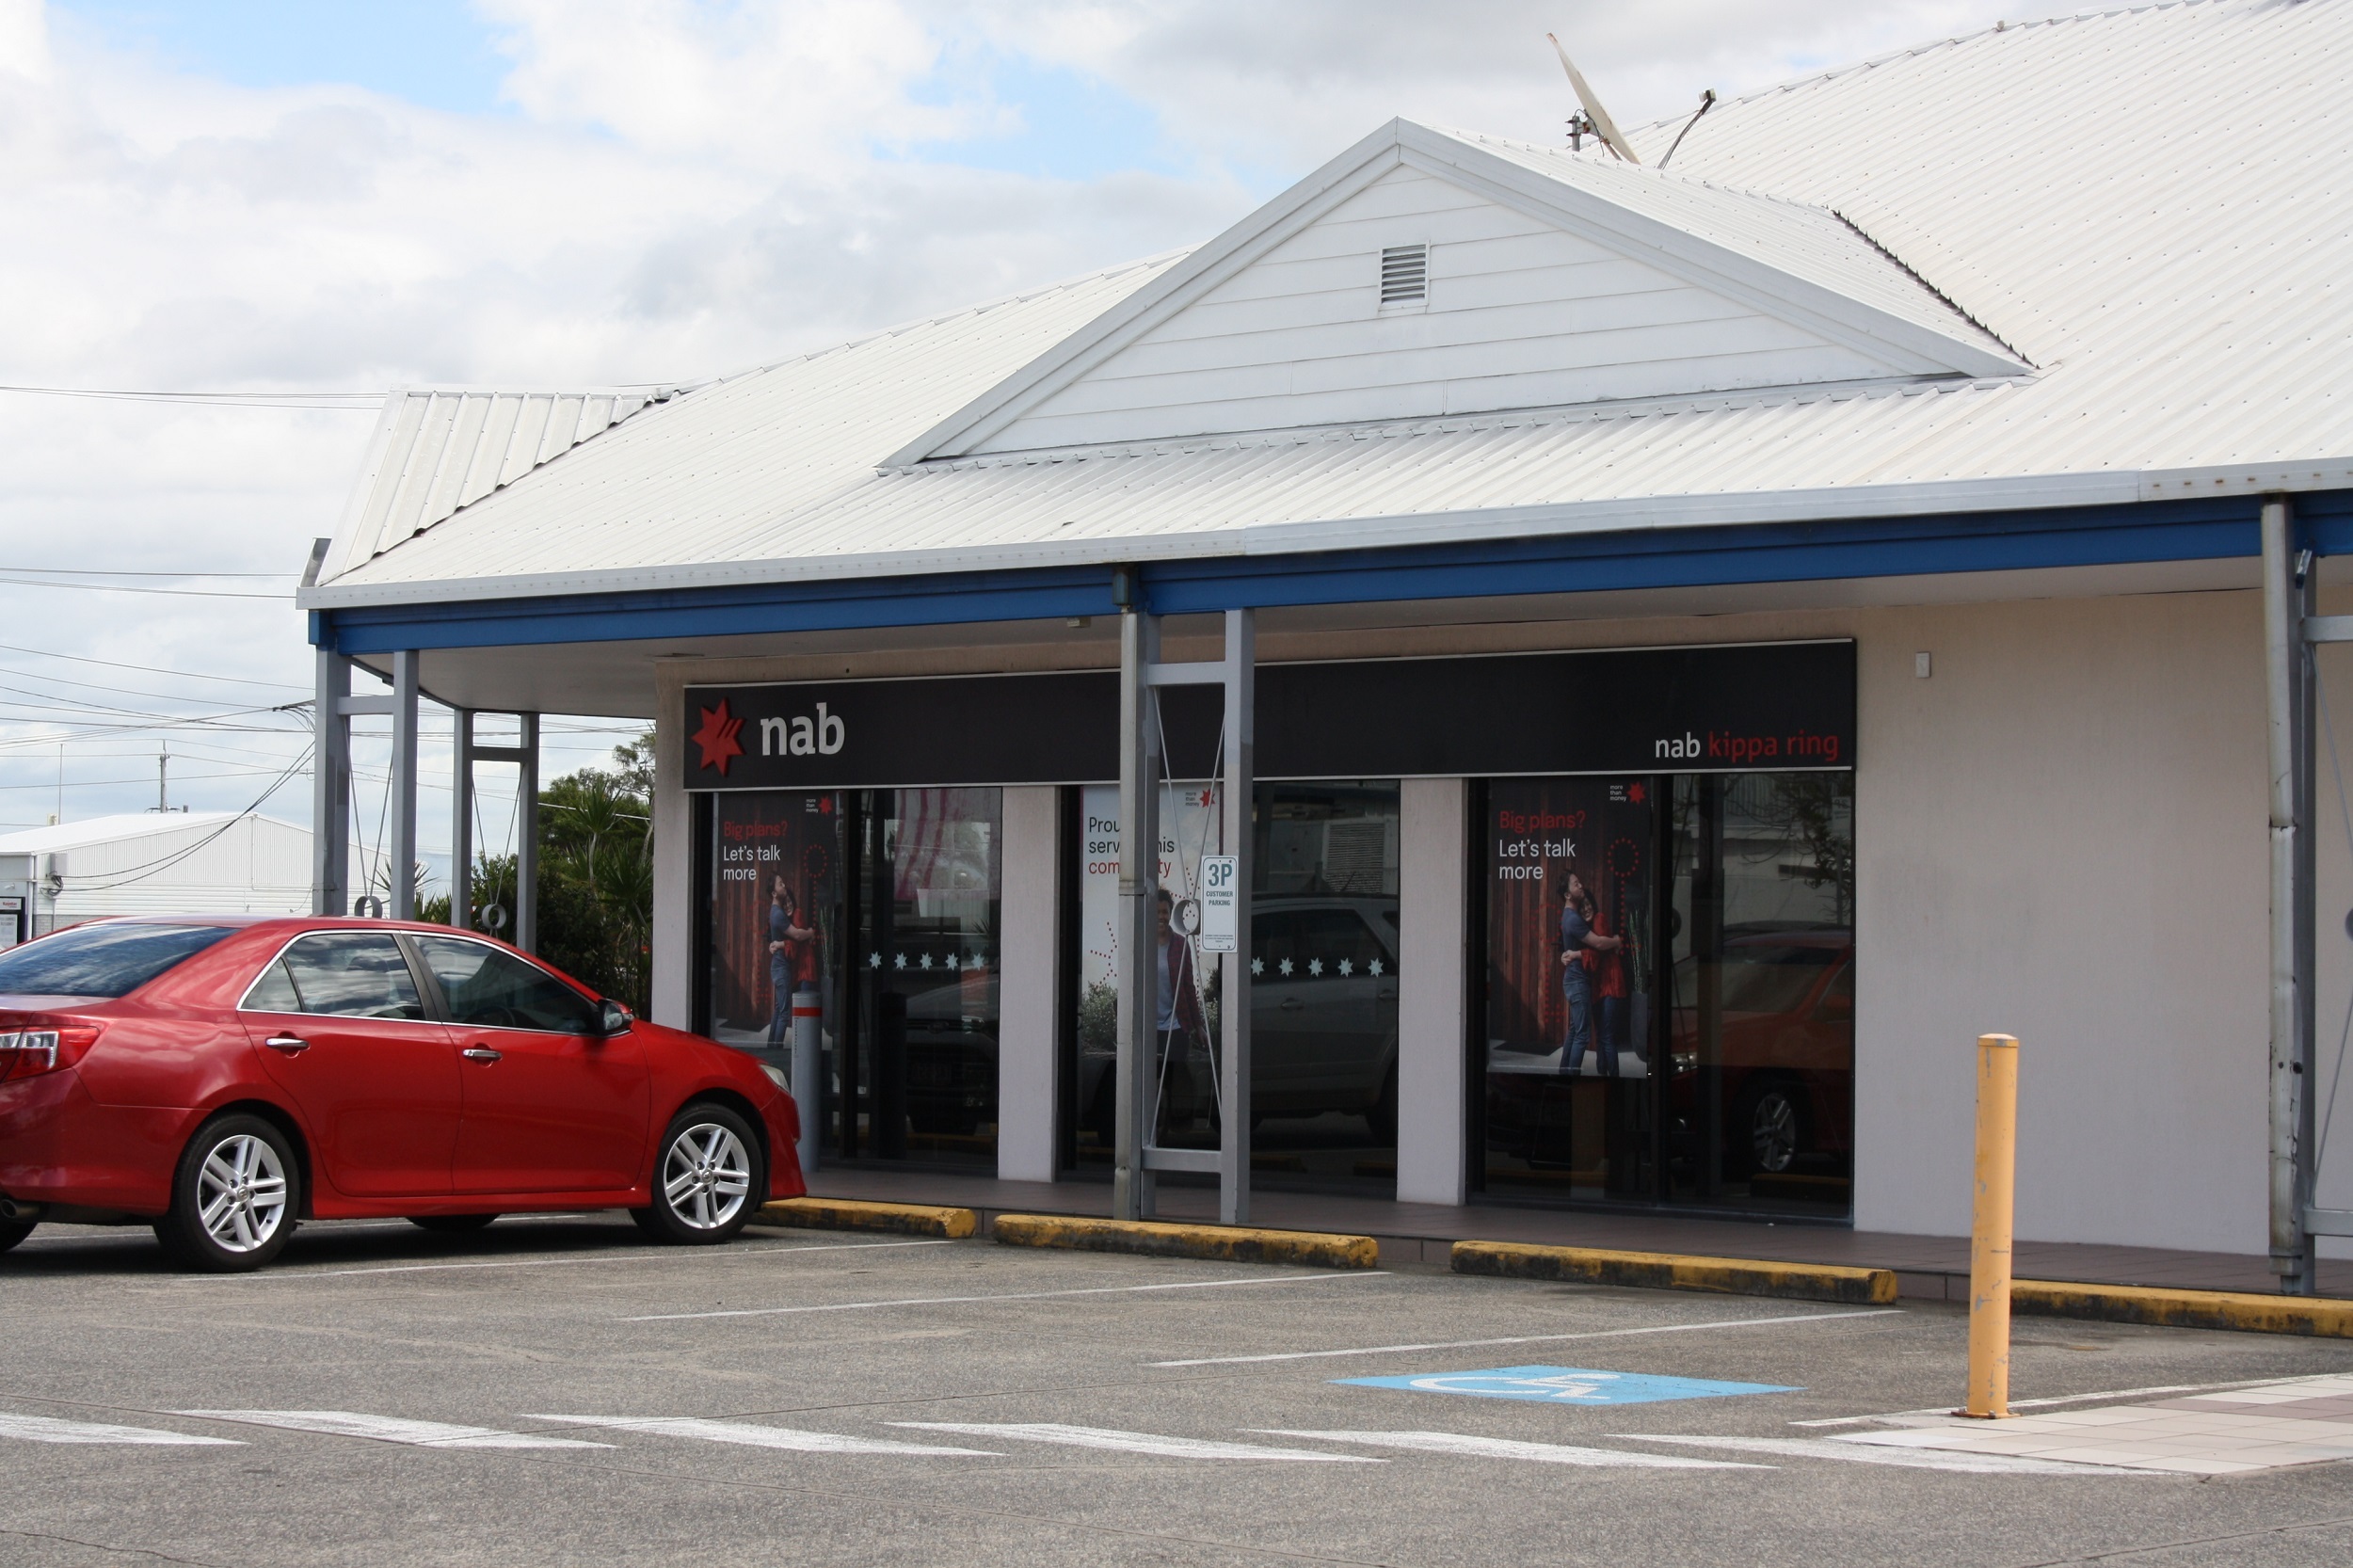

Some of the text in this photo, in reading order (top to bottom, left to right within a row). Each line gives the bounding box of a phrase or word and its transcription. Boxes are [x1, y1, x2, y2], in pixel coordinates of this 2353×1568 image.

[760, 701, 845, 756] nab
[1655, 728, 1840, 763] nab kippa ring
[723, 820, 789, 841] Big plans?
[1089, 816, 1121, 834] Prou
[1498, 809, 1587, 834] Big plans?
[723, 844, 781, 861] Let's talk
[1088, 840, 1120, 854] serv
[1498, 838, 1577, 857] Let's talk
[723, 868, 757, 880] more
[1208, 863, 1233, 887] 3P
[1498, 865, 1544, 879] more
